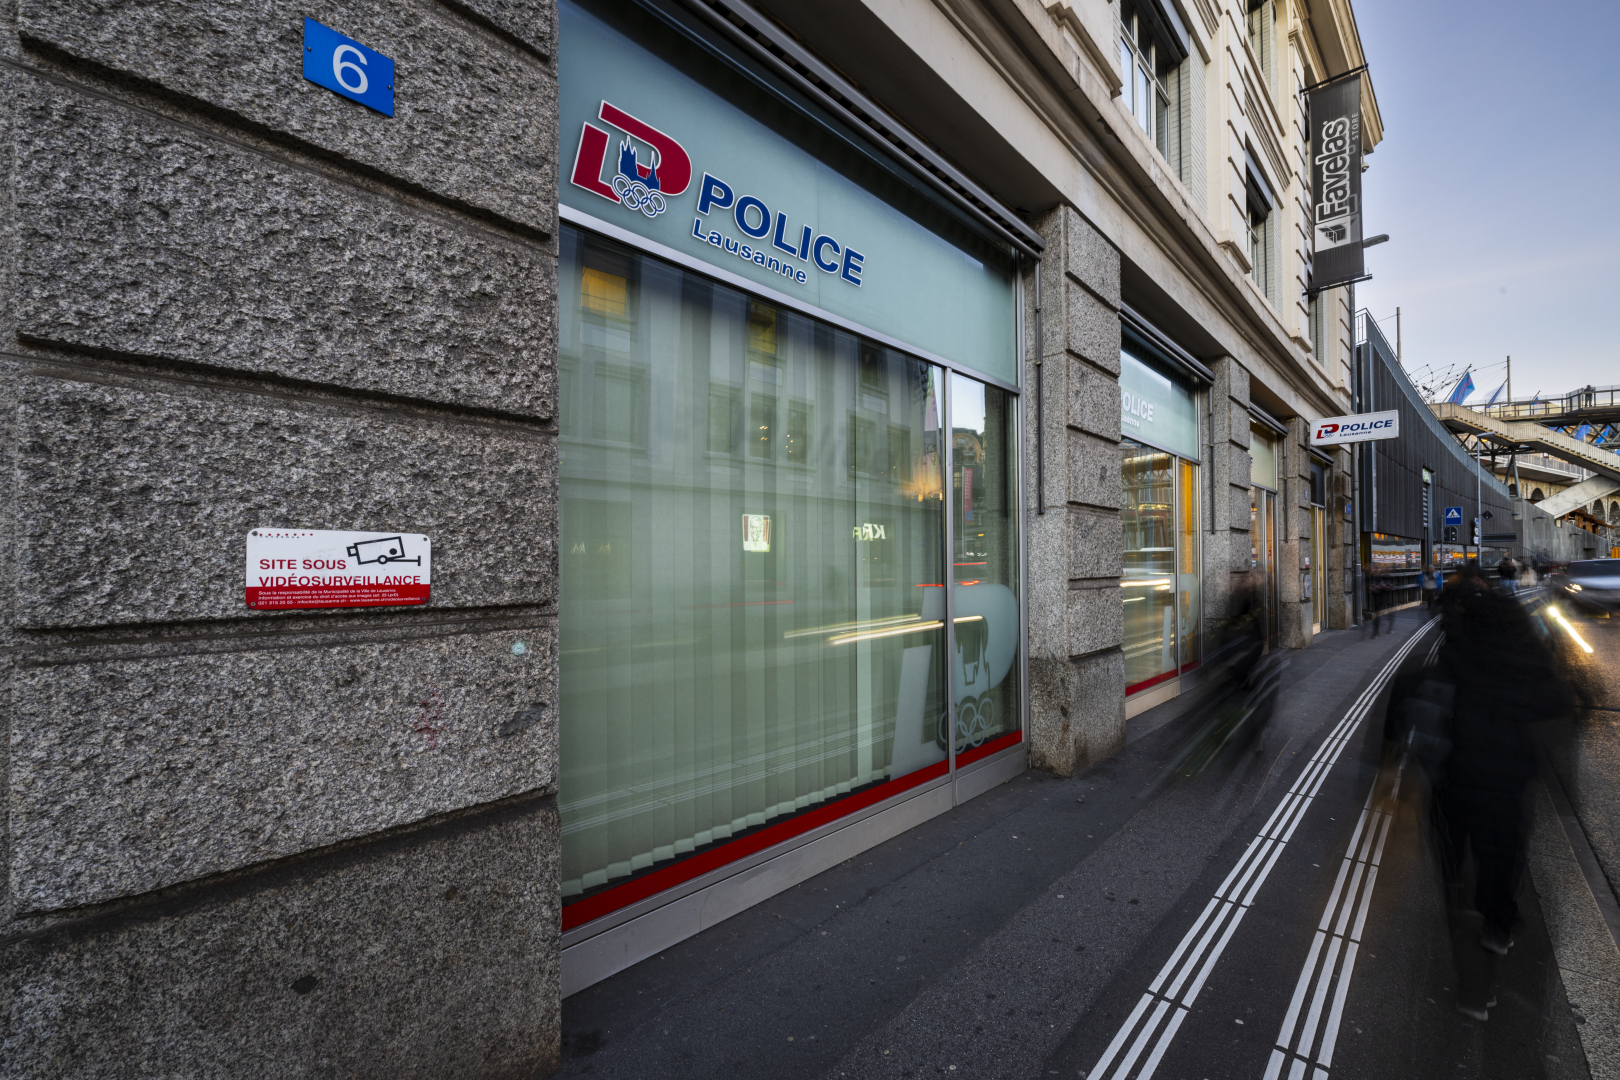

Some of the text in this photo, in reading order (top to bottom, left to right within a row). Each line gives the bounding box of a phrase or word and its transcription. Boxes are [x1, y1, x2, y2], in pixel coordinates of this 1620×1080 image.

[333, 44, 368, 94] 6
[1315, 116, 1351, 224] Favelas
[697, 171, 865, 287] POLICE
[692, 217, 808, 284] Lausanne
[1121, 390, 1154, 423] OLICE
[1341, 419, 1393, 433] POLICE
[259, 559, 347, 570] SITE SOUS
[259, 573, 421, 588] VIDÉOSURVEILLANCE
